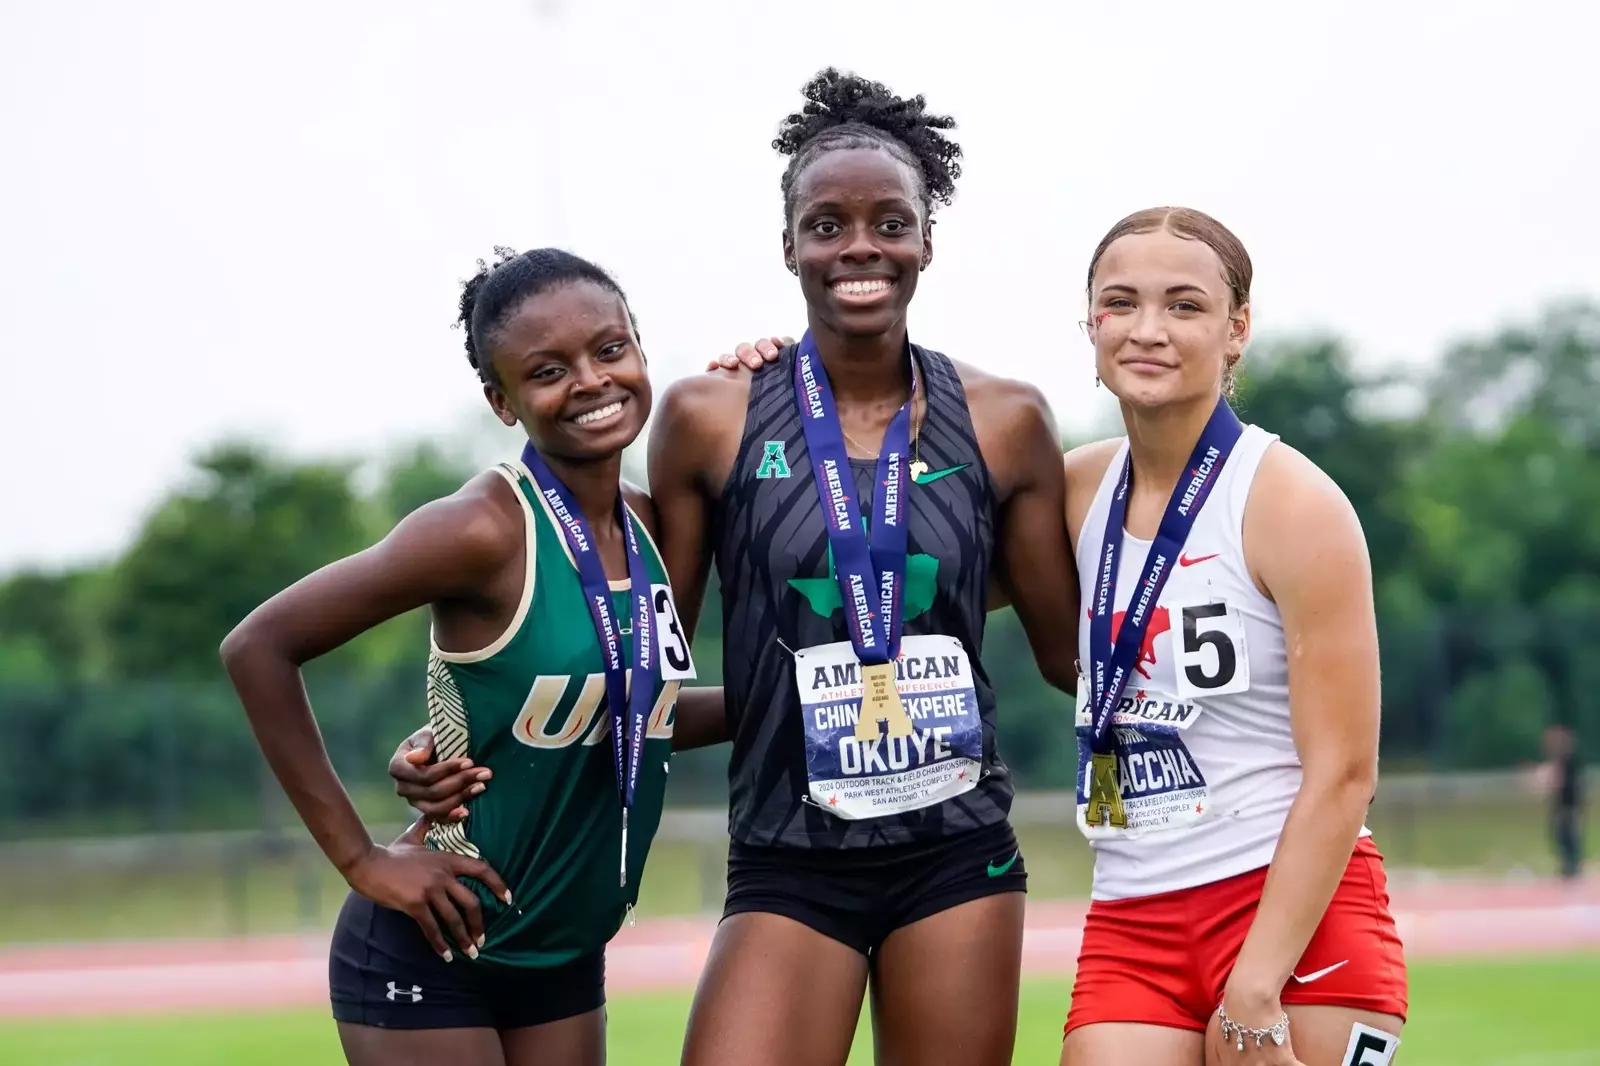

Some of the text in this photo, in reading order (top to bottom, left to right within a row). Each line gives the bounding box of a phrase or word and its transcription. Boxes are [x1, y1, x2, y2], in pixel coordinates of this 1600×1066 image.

[800, 354, 825, 419] AMERICAN
[824, 460, 851, 530] AMERICAN
[885, 453, 899, 527] AMERICAN
[1178, 446, 1220, 517] AMERICAN
[543, 488, 590, 552] AMERICAN
[849, 574, 876, 648] AMERICAN
[881, 571, 894, 646] ERICAN
[1097, 543, 1114, 616] AMERICAN
[1132, 554, 1166, 627] AMERICAN
[595, 595, 619, 670] AMERICAN
[638, 595, 650, 670] AMERICAN
[655, 589, 690, 671] 3
[1182, 603, 1236, 689] 5
[812, 655, 961, 691] AMICAN
[821, 681, 957, 701] ATHLET NFERENCE
[1095, 666, 1124, 738] AMERICAN
[630, 714, 643, 789] AMERICAN
[818, 783, 834, 792] 2024
[835, 779, 870, 790] OUTDOOR
[872, 777, 896, 786] TRACK
[903, 771, 921, 782] FIELD
[922, 759, 974, 777] CHAMPIONSHIPS
[844, 774, 953, 799] PARK WEST ATHLETICS COMPLEX
[1083, 748, 1200, 799] ACCHIA
[872, 798, 887, 806] SAN
[920, 789, 930, 797] TX
